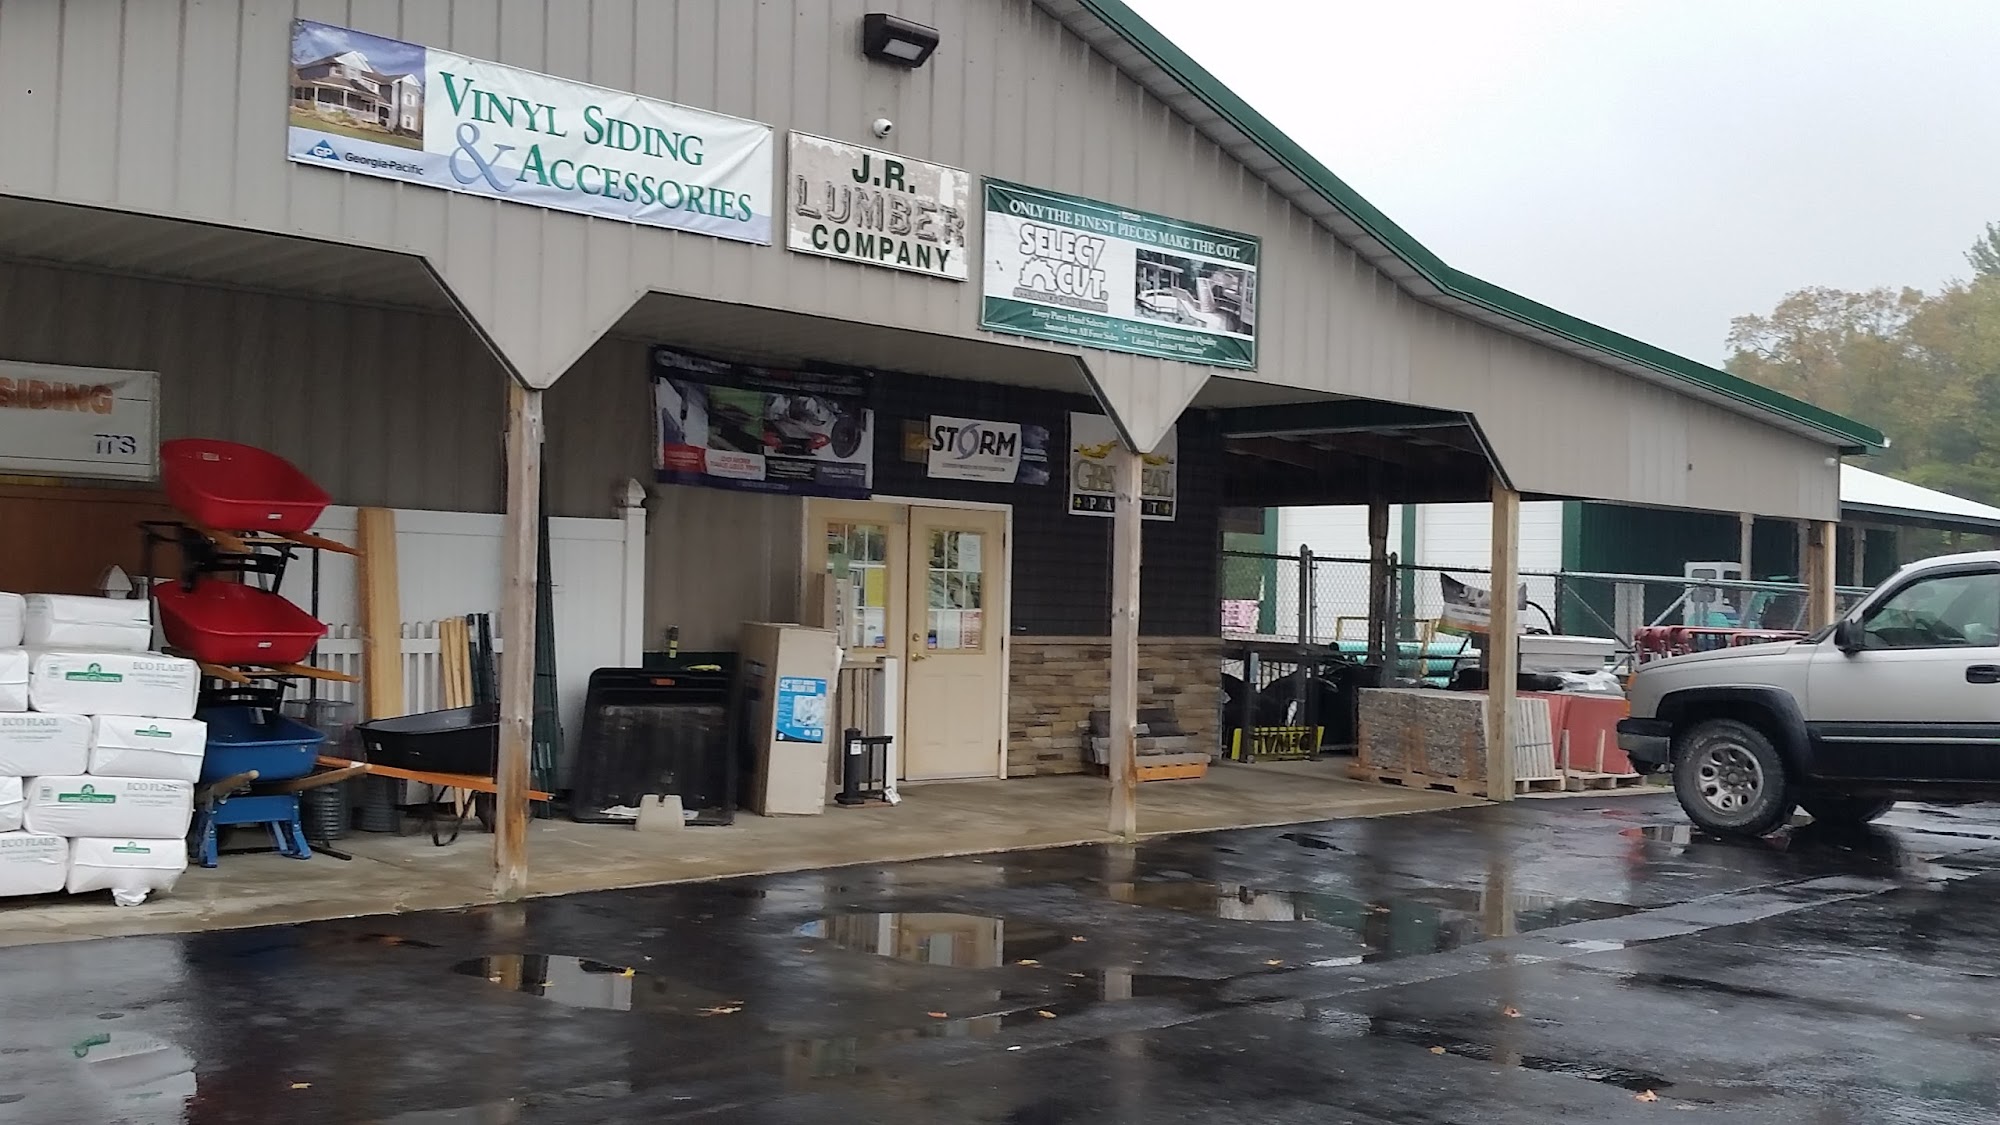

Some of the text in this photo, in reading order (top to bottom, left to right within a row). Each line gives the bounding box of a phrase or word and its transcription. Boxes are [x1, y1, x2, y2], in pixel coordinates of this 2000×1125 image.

[439, 71, 704, 166] VINYL SIDING
[313, 146, 333, 157] GP
[345, 152, 424, 175] Georgia-Pacific
[449, 122, 752, 222] & ACCESSORIES
[852, 154, 916, 194] J.R.
[795, 174, 965, 248] LUMBER
[1009, 199, 1044, 219] ONLY
[1043, 206, 1073, 225] THE
[1074, 212, 1117, 234] FINEST
[1117, 221, 1158, 242] PIECES
[1158, 231, 1190, 250] MAKE
[1190, 238, 1216, 254] THE
[1216, 243, 1241, 260] CUT.
[812, 223, 950, 272] COMPANY
[1019, 223, 1106, 268] SELECT
[0, 377, 113, 415] SIDING
[933, 423, 1017, 459] STORM
